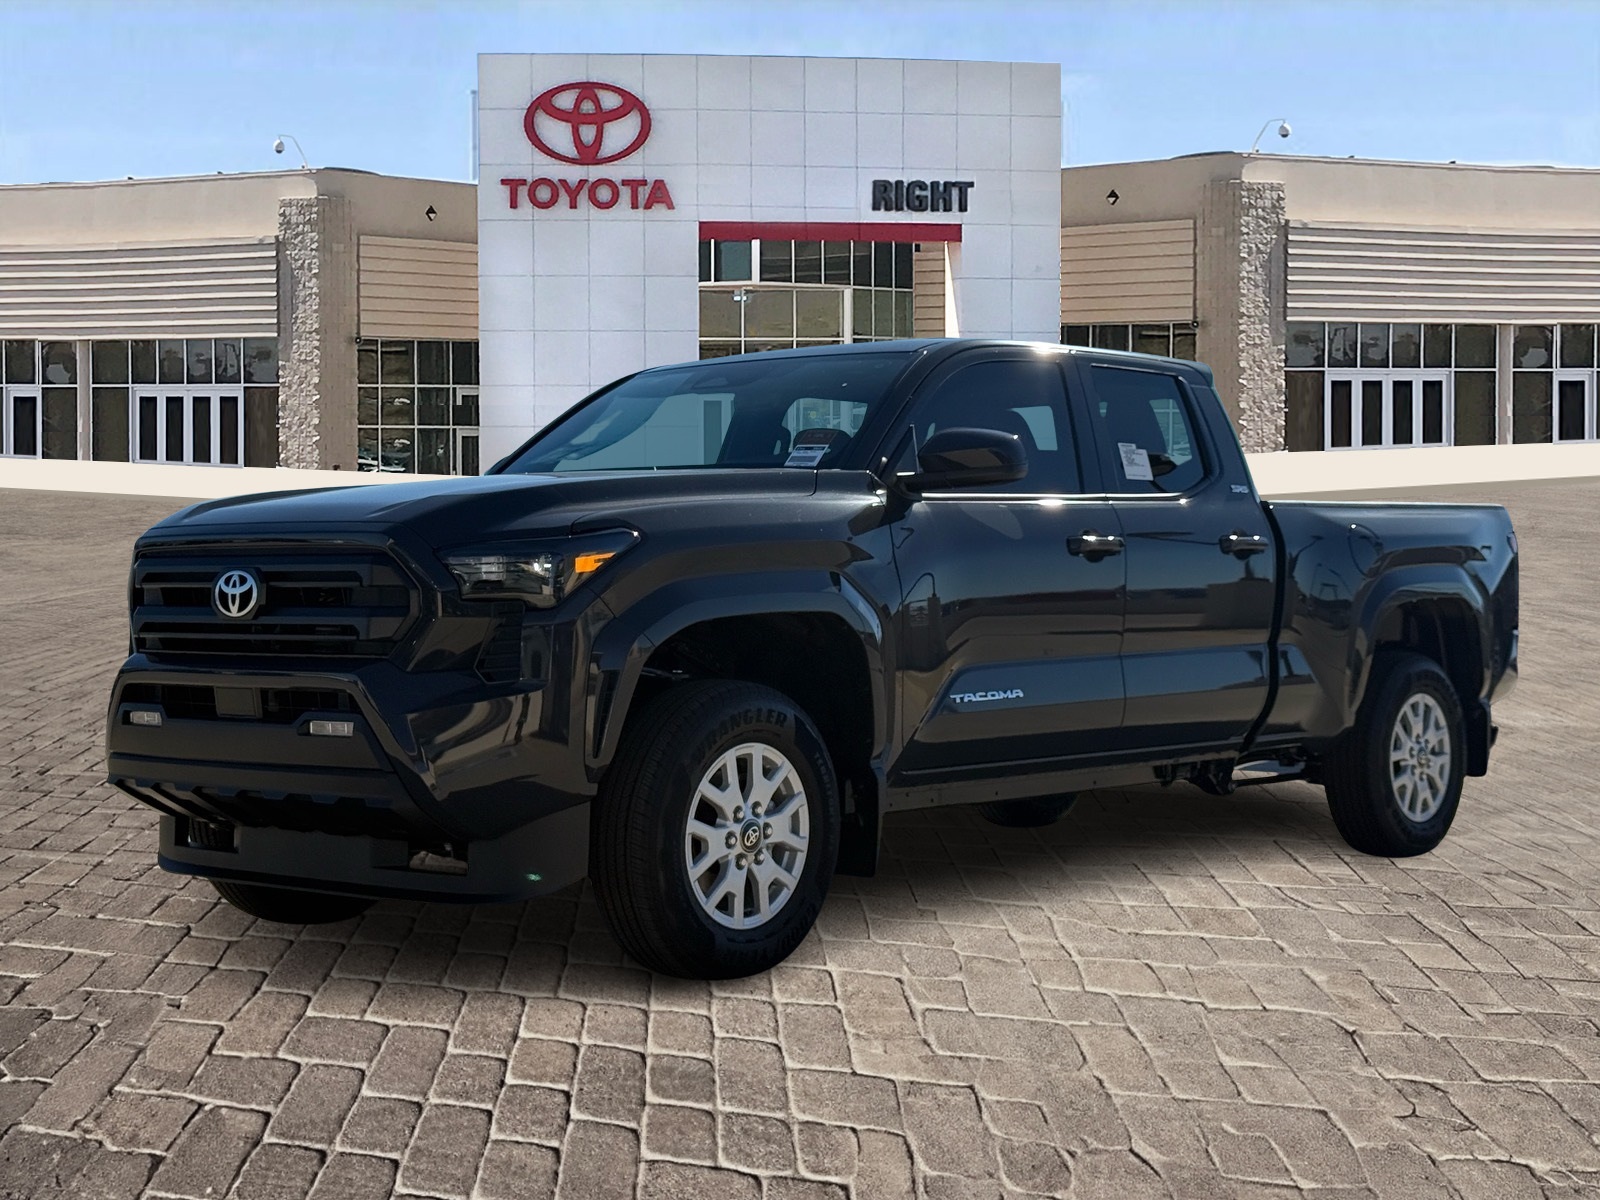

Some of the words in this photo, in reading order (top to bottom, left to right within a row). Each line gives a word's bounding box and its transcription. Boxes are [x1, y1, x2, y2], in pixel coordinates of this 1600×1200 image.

[500, 178, 675, 210] TOYOTA
[872, 179, 974, 213] RIGHT
[950, 688, 1024, 704] TACOMA
